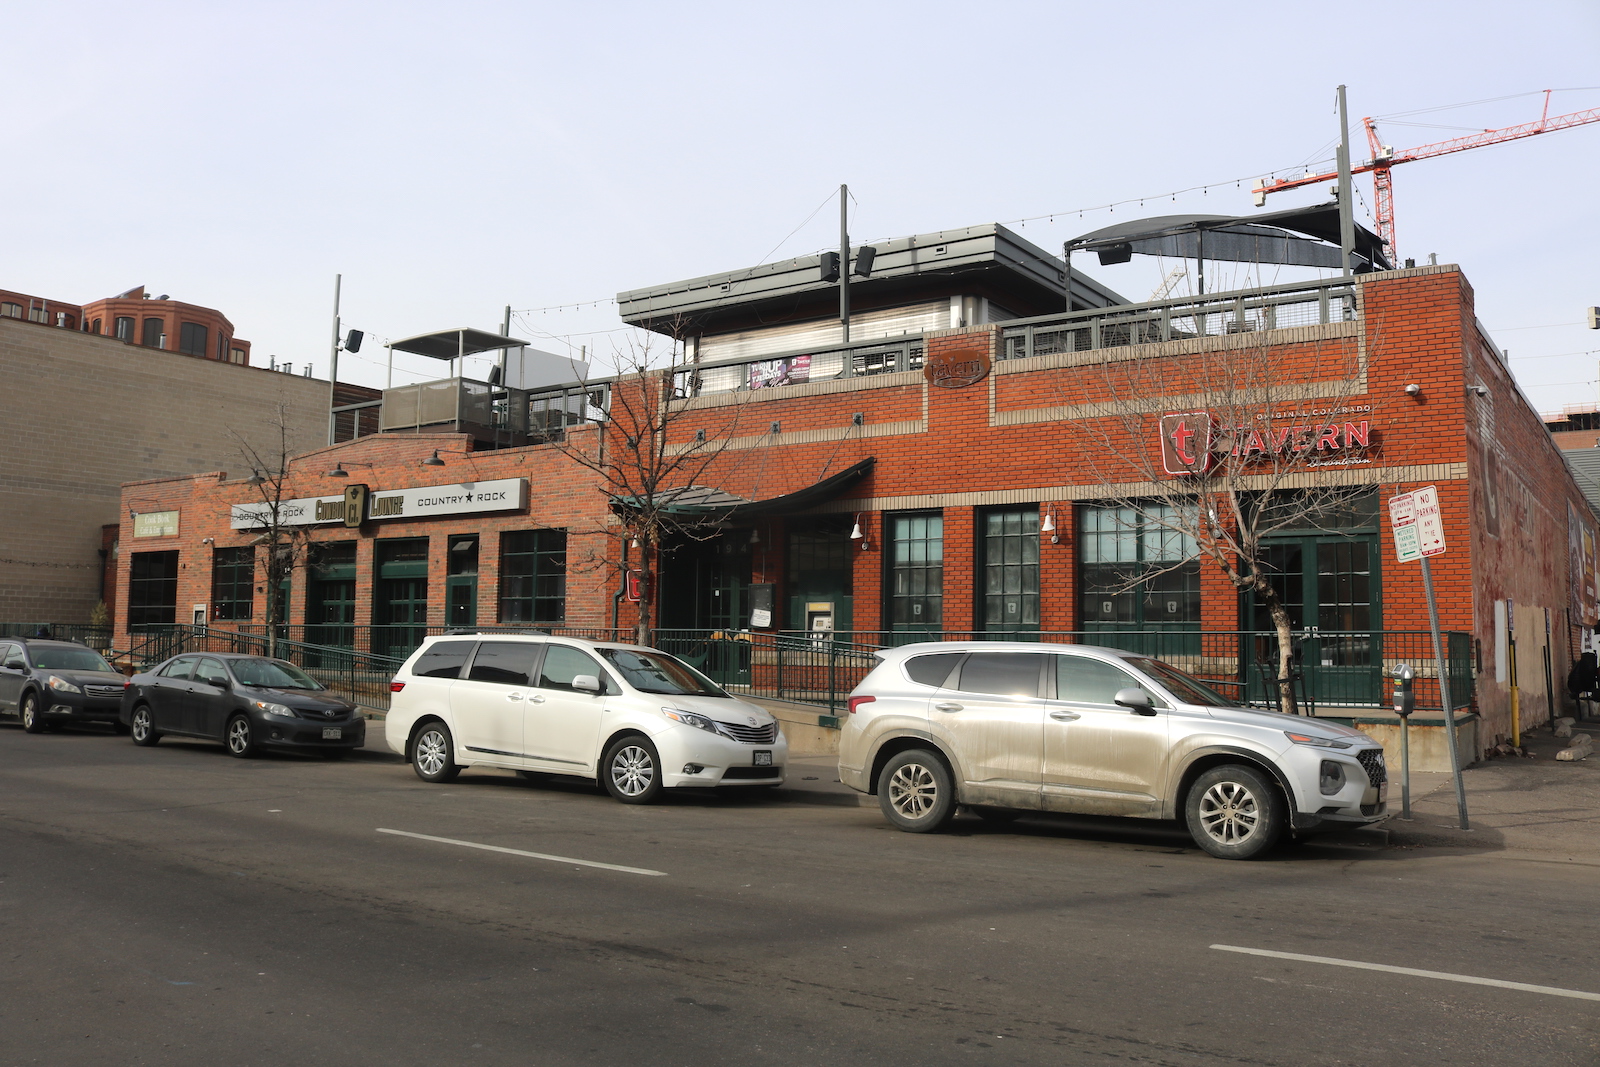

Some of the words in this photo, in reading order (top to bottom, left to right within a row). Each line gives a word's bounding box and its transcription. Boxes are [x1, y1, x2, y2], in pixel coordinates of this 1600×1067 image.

[1221, 421, 1369, 457] TAVERN
[283, 509, 304, 517] ROCK
[370, 494, 404, 517] LOUNGE
[417, 495, 464, 507] COUNTRY
[477, 491, 506, 502] ROCK
[1420, 493, 1430, 505] NO
[349, 503, 358, 523] CL
[1417, 504, 1437, 518] PARKING
[1399, 534, 1415, 542] PARKING
